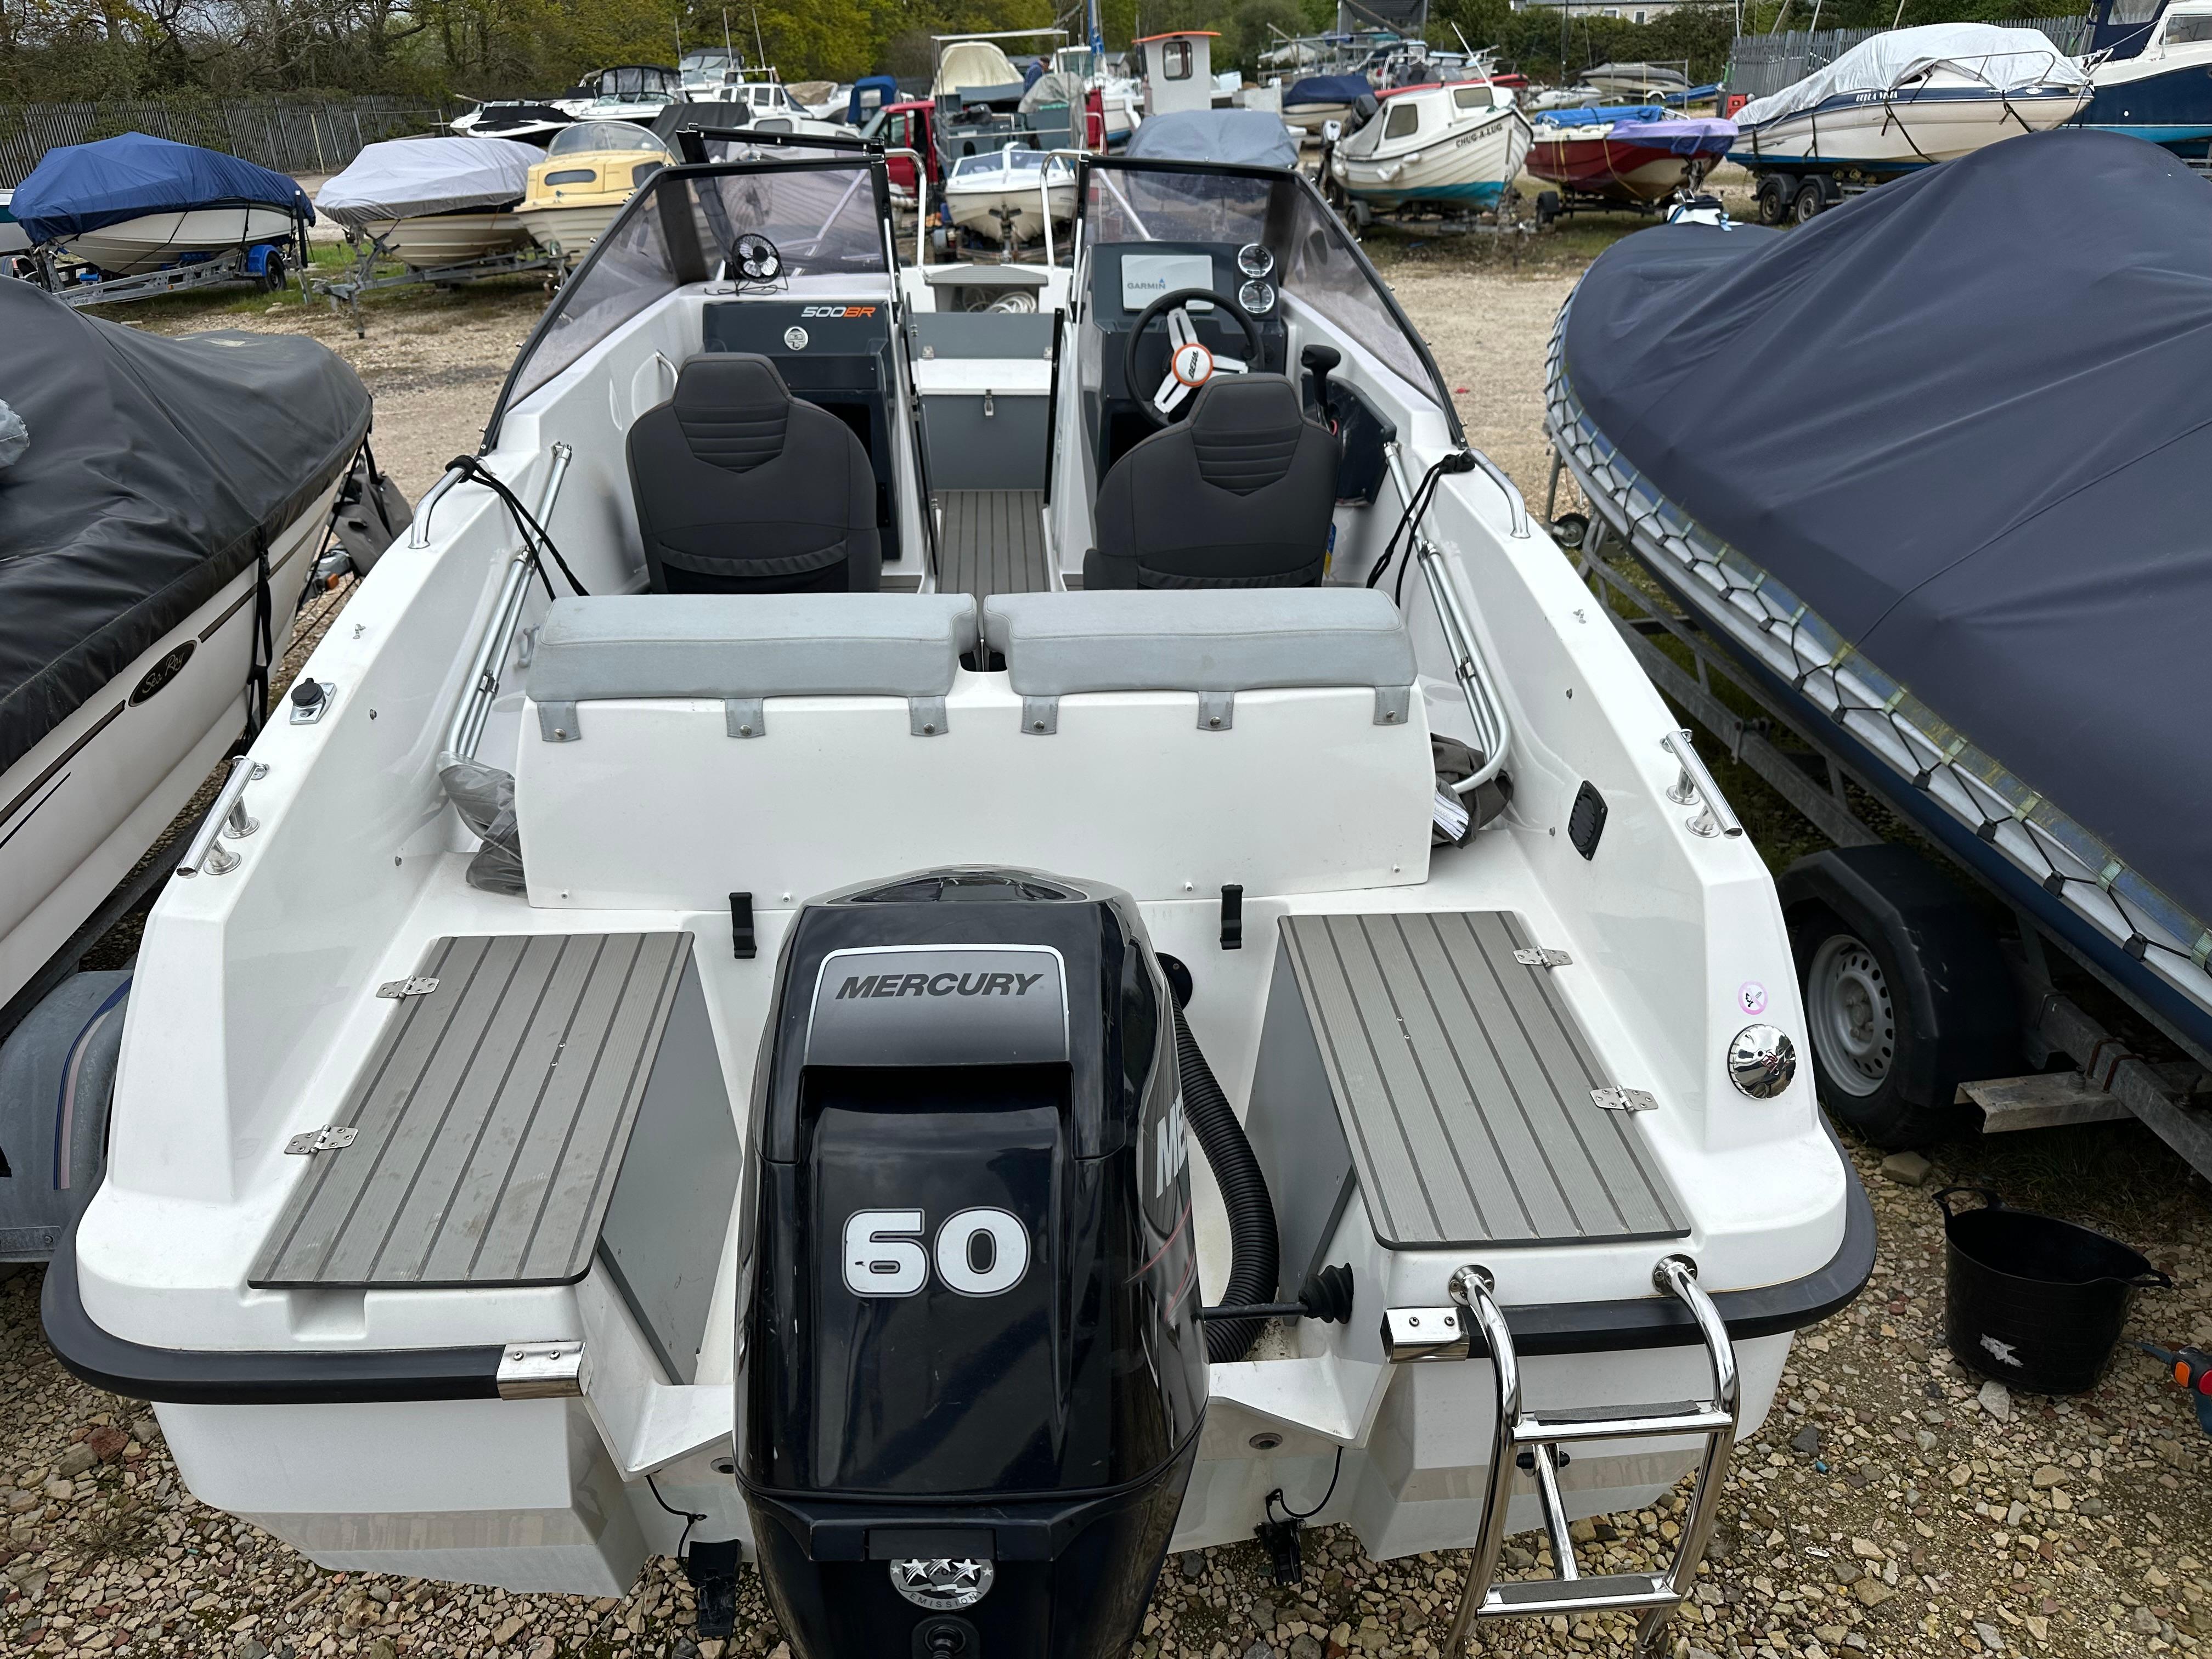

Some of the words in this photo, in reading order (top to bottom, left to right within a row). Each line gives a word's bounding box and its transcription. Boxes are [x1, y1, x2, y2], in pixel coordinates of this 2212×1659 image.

[801, 306, 876, 317] 500BR
[142, 672, 162, 694] Sea
[165, 652, 185, 676] Ray
[835, 973, 1045, 1000] MERCURY
[842, 1206, 1031, 1298] 60
[909, 1593, 977, 1609] EMISSION
